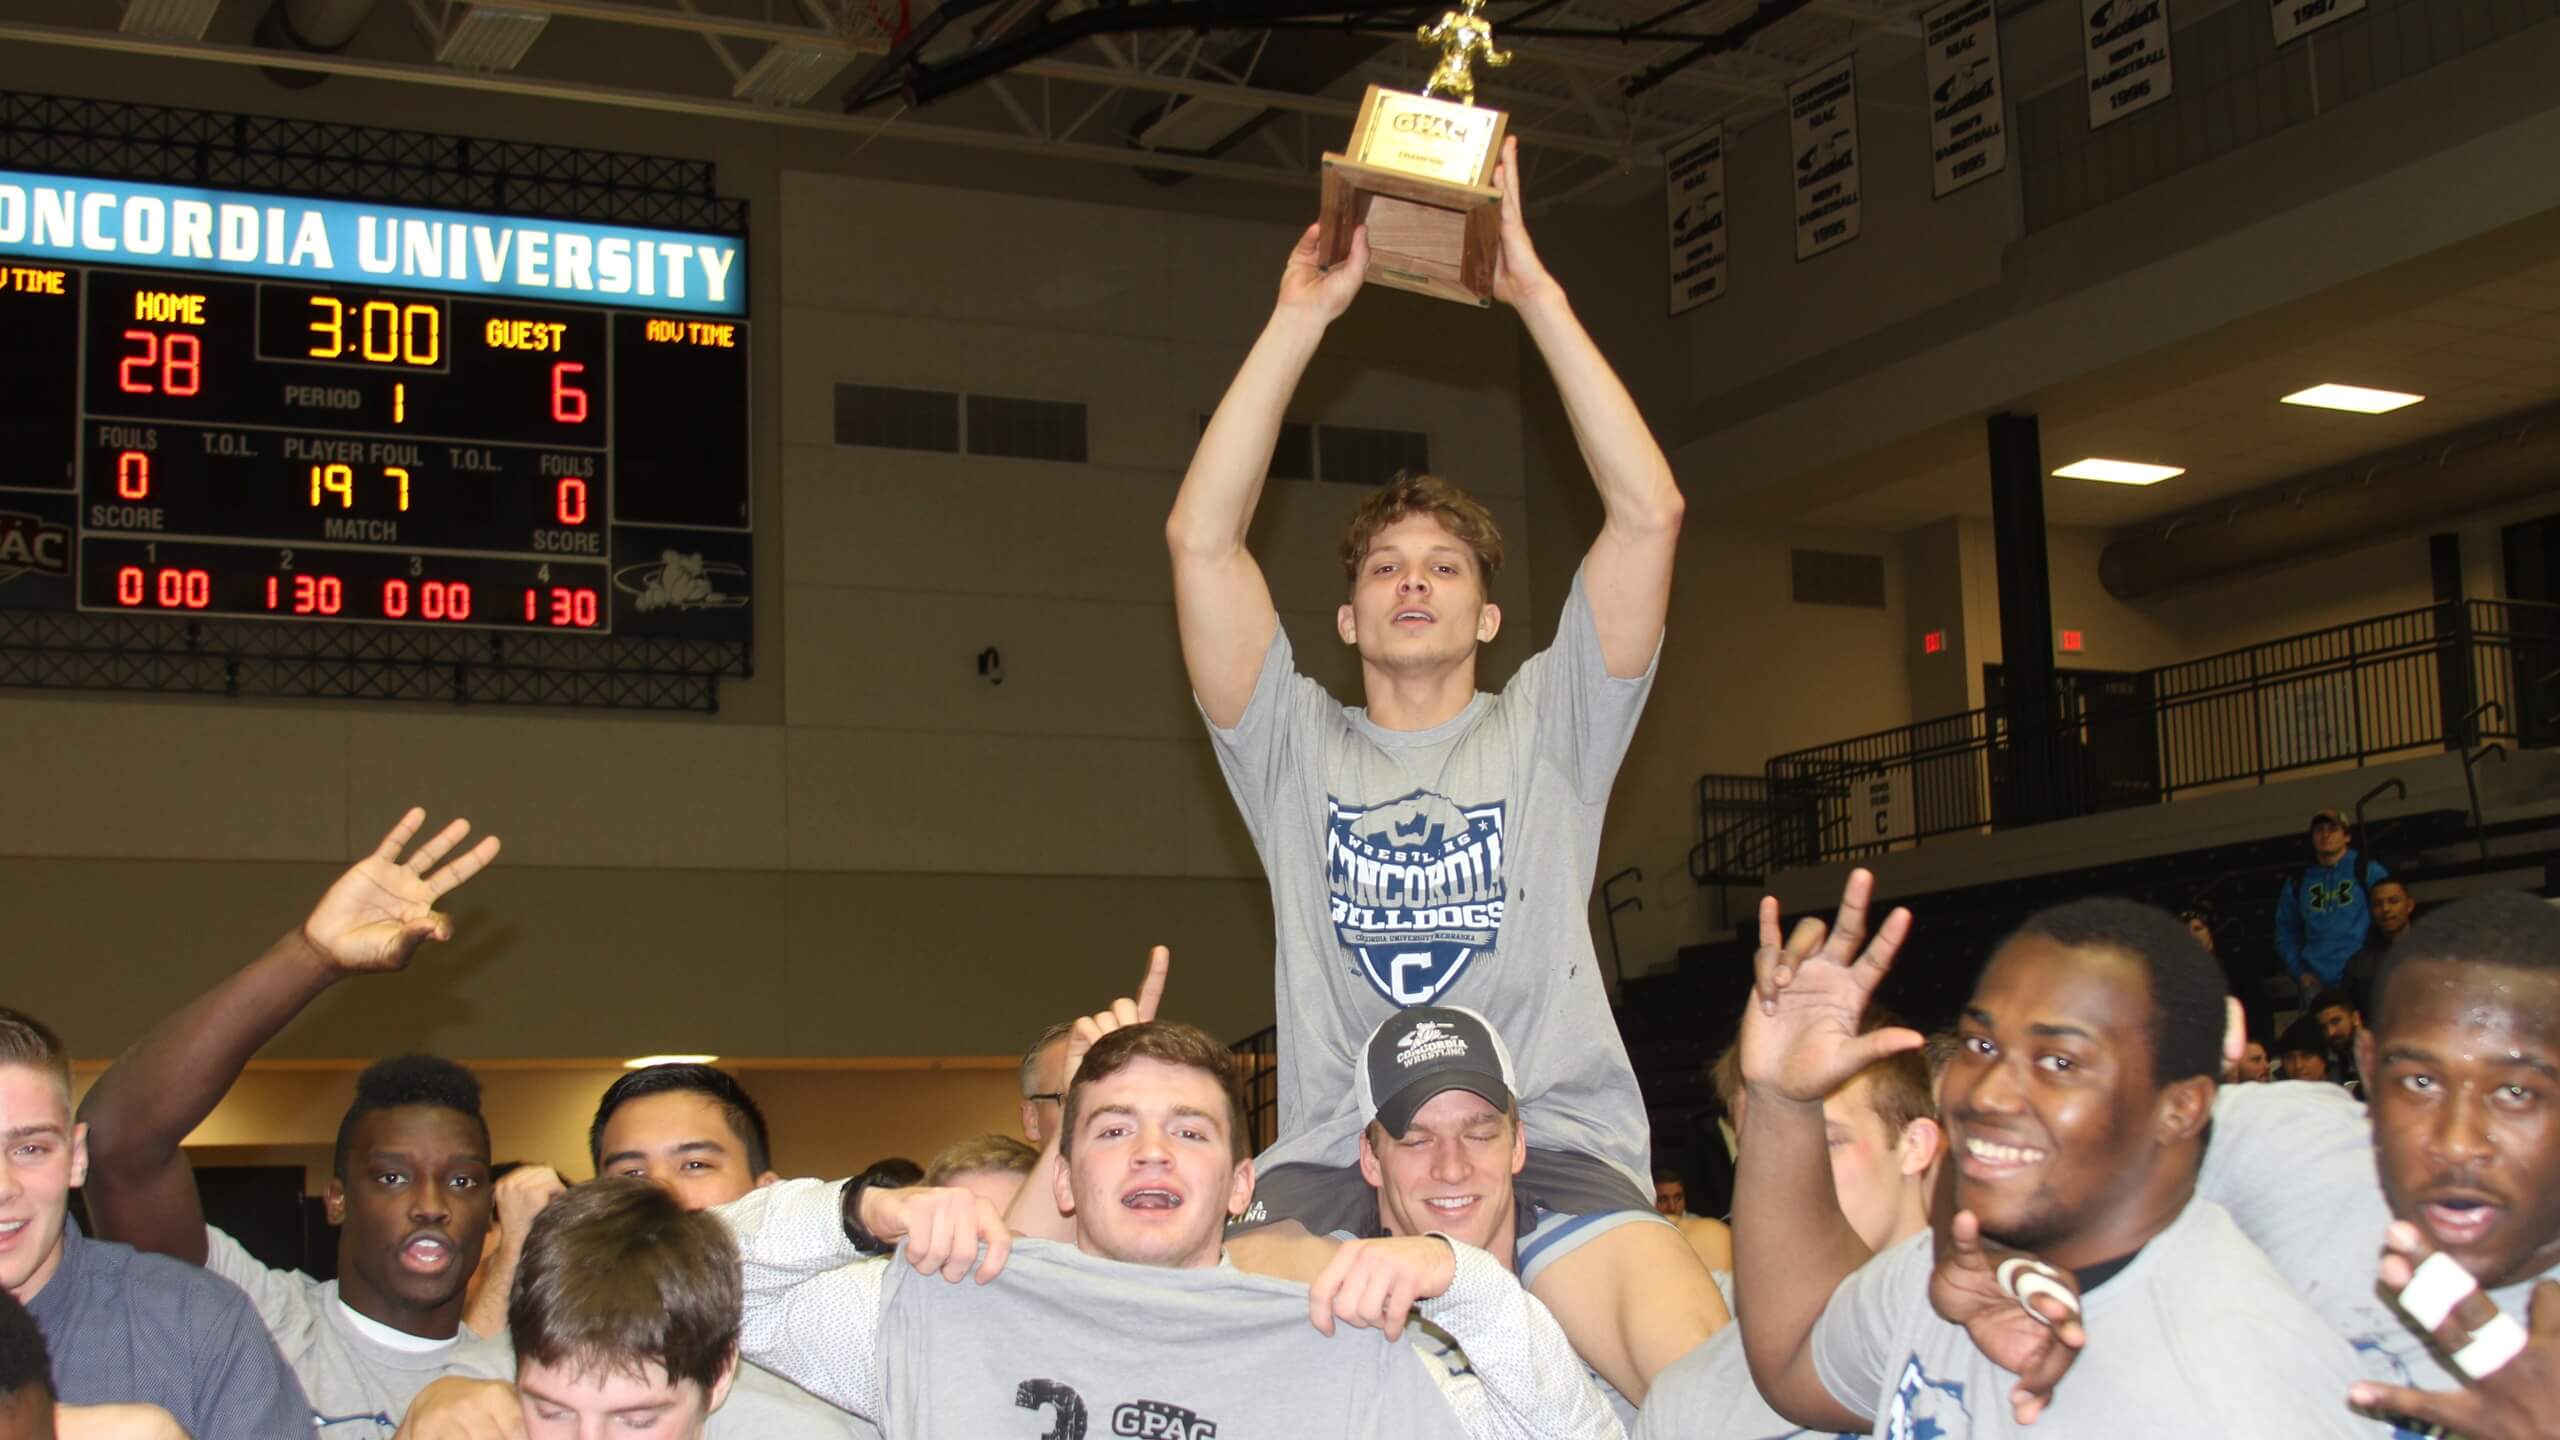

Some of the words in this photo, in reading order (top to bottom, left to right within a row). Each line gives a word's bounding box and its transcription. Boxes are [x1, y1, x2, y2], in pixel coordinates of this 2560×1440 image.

[358, 215, 735, 302] UNIVERSITY
[10, 267, 66, 294] TIME
[135, 290, 206, 325] HOME
[309, 296, 439, 365] 3:00
[486, 318, 567, 352] GUEST
[688, 321, 735, 347] TIME
[120, 330, 199, 396] 28
[285, 385, 361, 409] PERIOD
[394, 382, 404, 423] 1
[552, 361, 587, 422] 6
[99, 426, 158, 450] FOULS
[284, 437, 364, 463] PLAYER
[370, 443, 423, 467] FOUL
[119, 451, 148, 499] 0
[541, 454, 594, 477] FOULS
[384, 467, 409, 512] 7
[558, 477, 586, 524] 0
[91, 505, 164, 530] SCORE
[325, 517, 398, 541] MATCH
[146, 543, 156, 563] 1
[533, 530, 600, 553] SCORE
[280, 550, 293, 571] 2
[410, 556, 423, 577] 3
[537, 562, 550, 584] 4
[1348, 832, 1471, 864] WRESTLNG
[1391, 952, 1435, 1005] C
[1396, 1038, 1468, 1064] CONCORDIA
[1403, 1047, 1466, 1069] WRESTLING
[1113, 1405, 1216, 1440] GPAC
